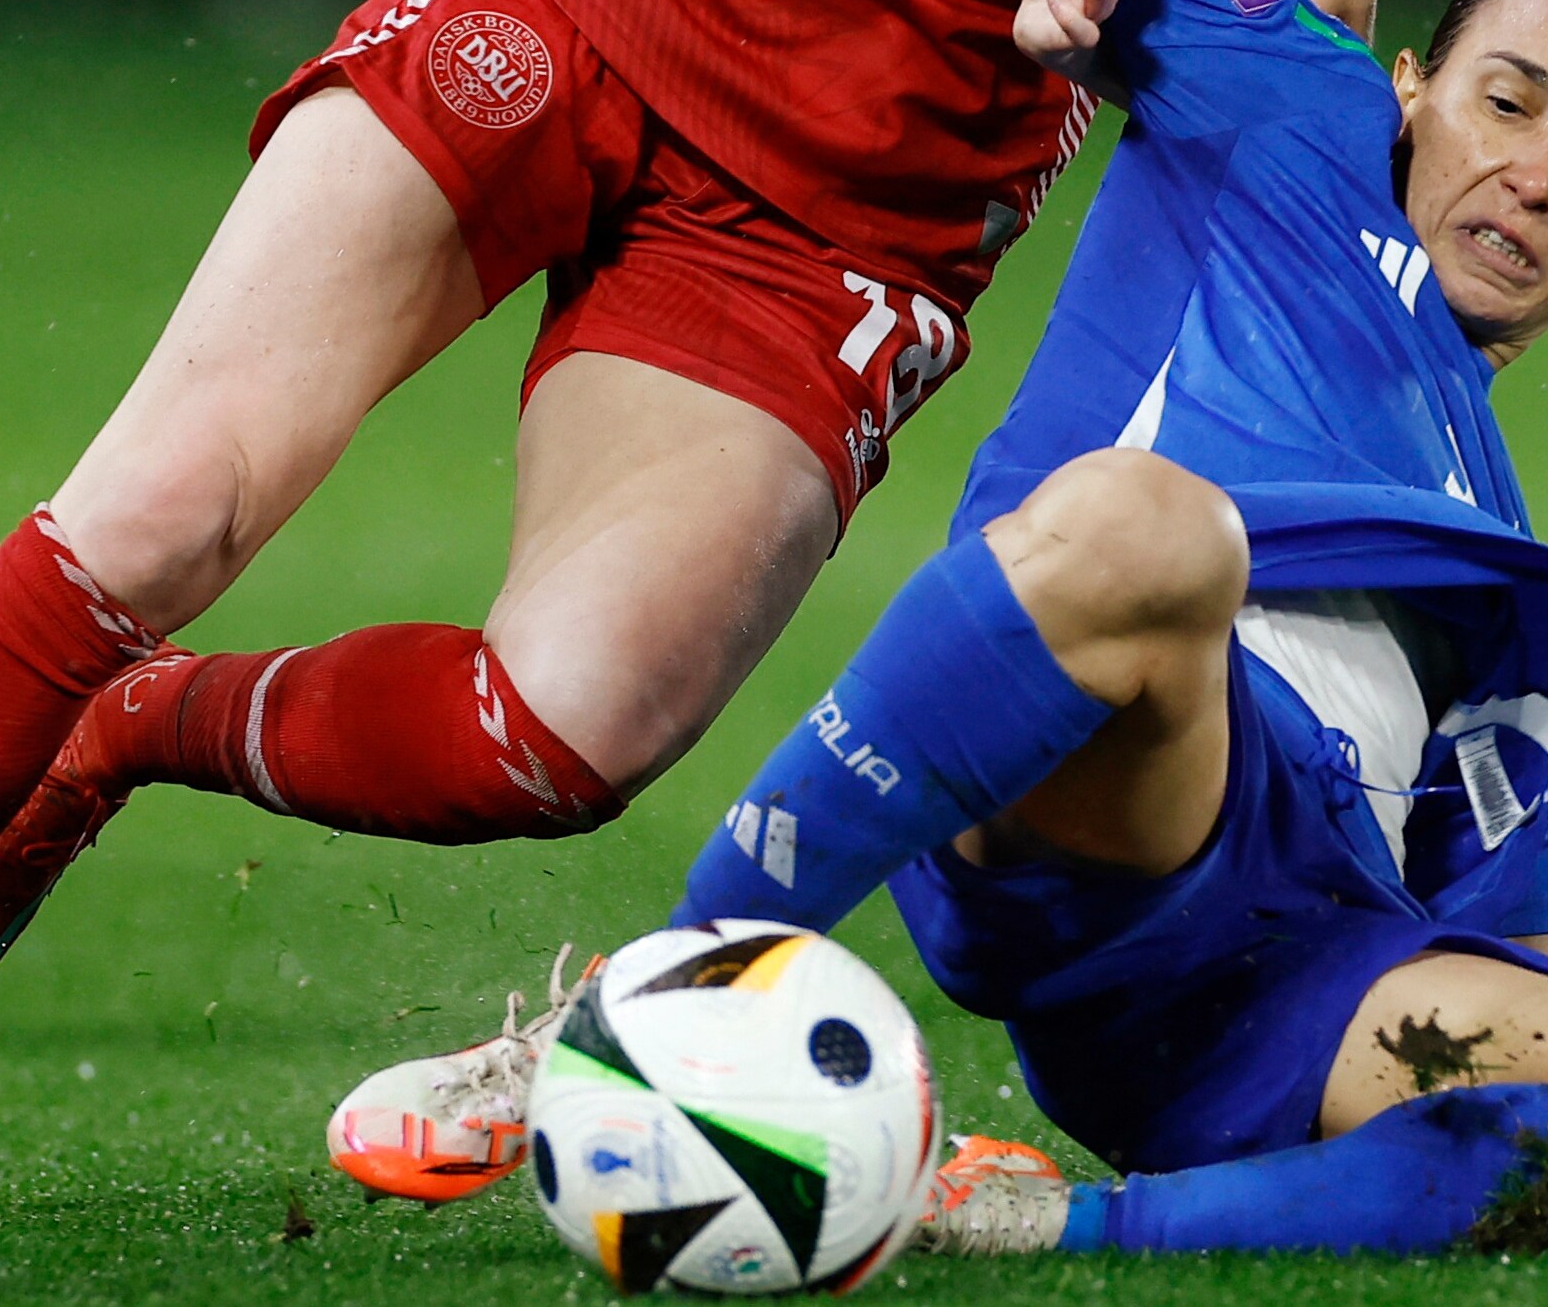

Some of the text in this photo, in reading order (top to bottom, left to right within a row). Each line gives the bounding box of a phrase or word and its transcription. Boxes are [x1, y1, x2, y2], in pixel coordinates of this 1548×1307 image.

[433, 17, 479, 70] DANSK
[455, 34, 528, 102] DBU
[437, 80, 478, 118] 1889
[487, 87, 543, 124] UNION
[838, 270, 955, 436] 18
